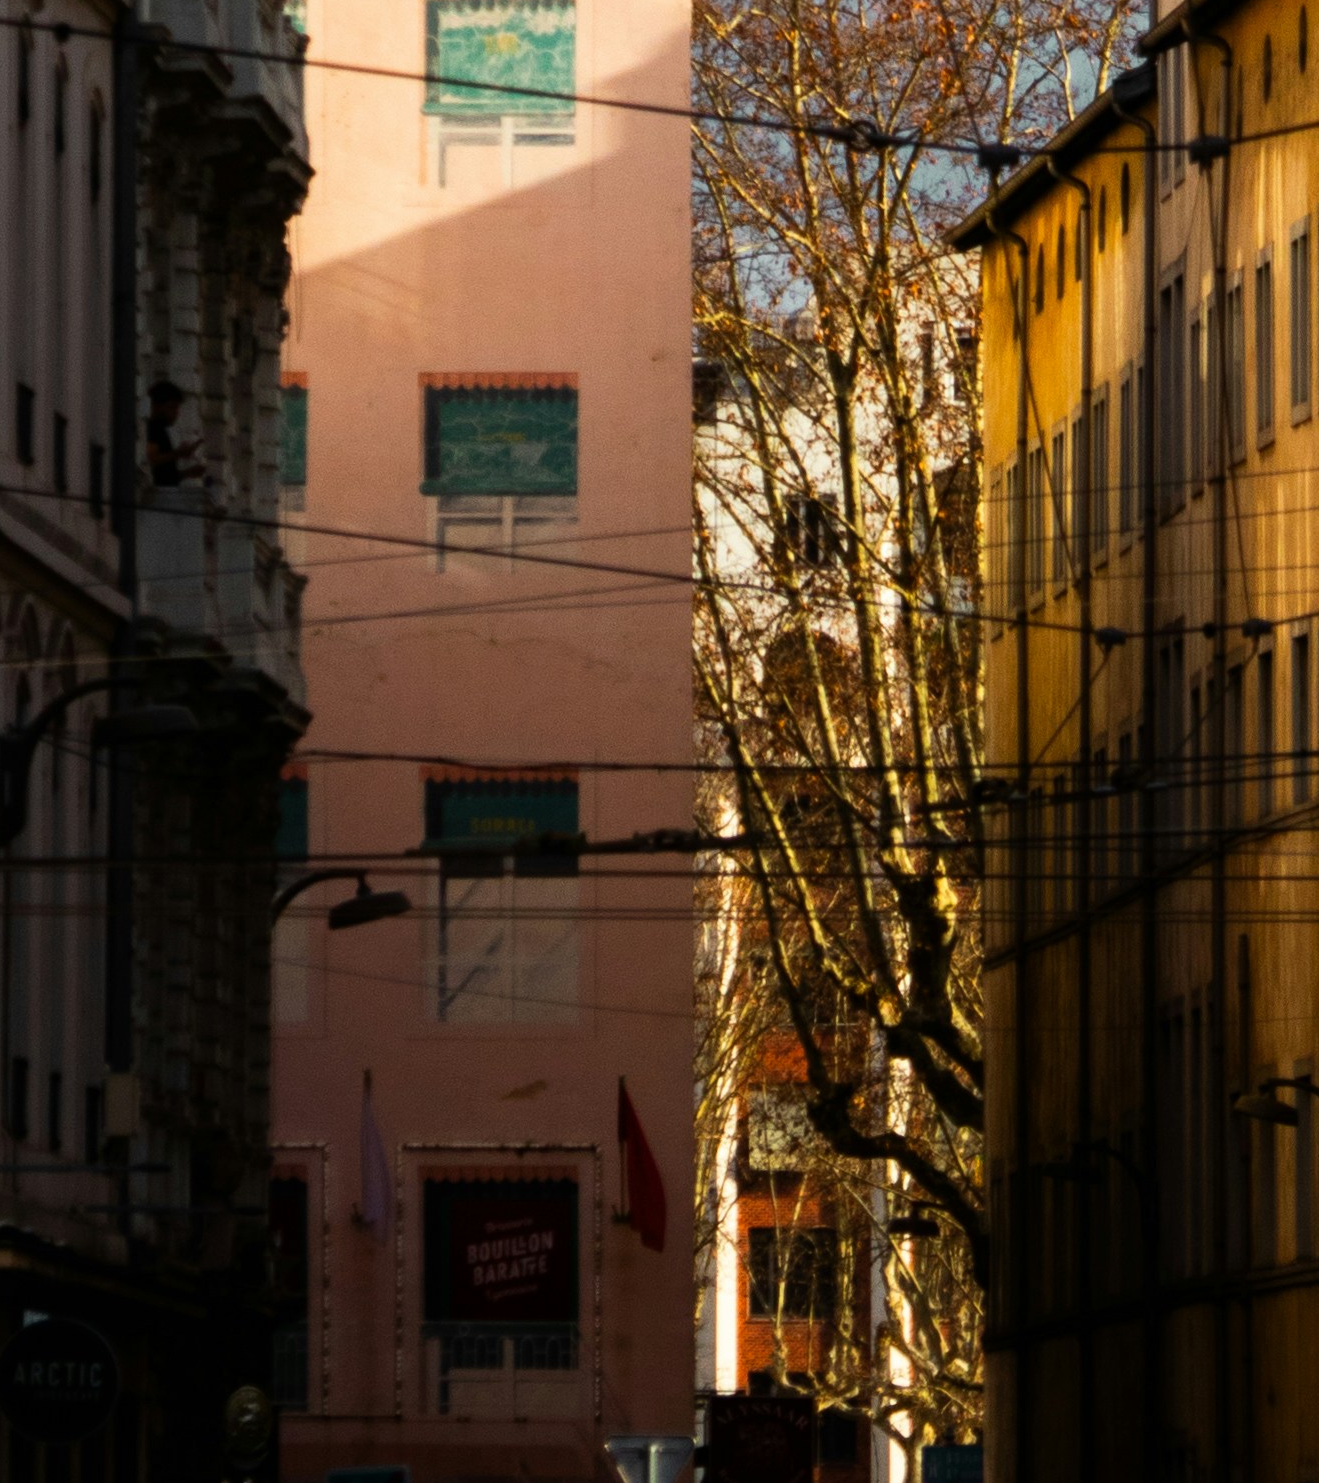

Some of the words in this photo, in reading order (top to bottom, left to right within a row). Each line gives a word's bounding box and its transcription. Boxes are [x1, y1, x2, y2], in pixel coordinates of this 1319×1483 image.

[466, 1229, 556, 1265] BOUILLON
[472, 1253, 551, 1287] BARATTE
[13, 1360, 104, 1388] ARCTIC
